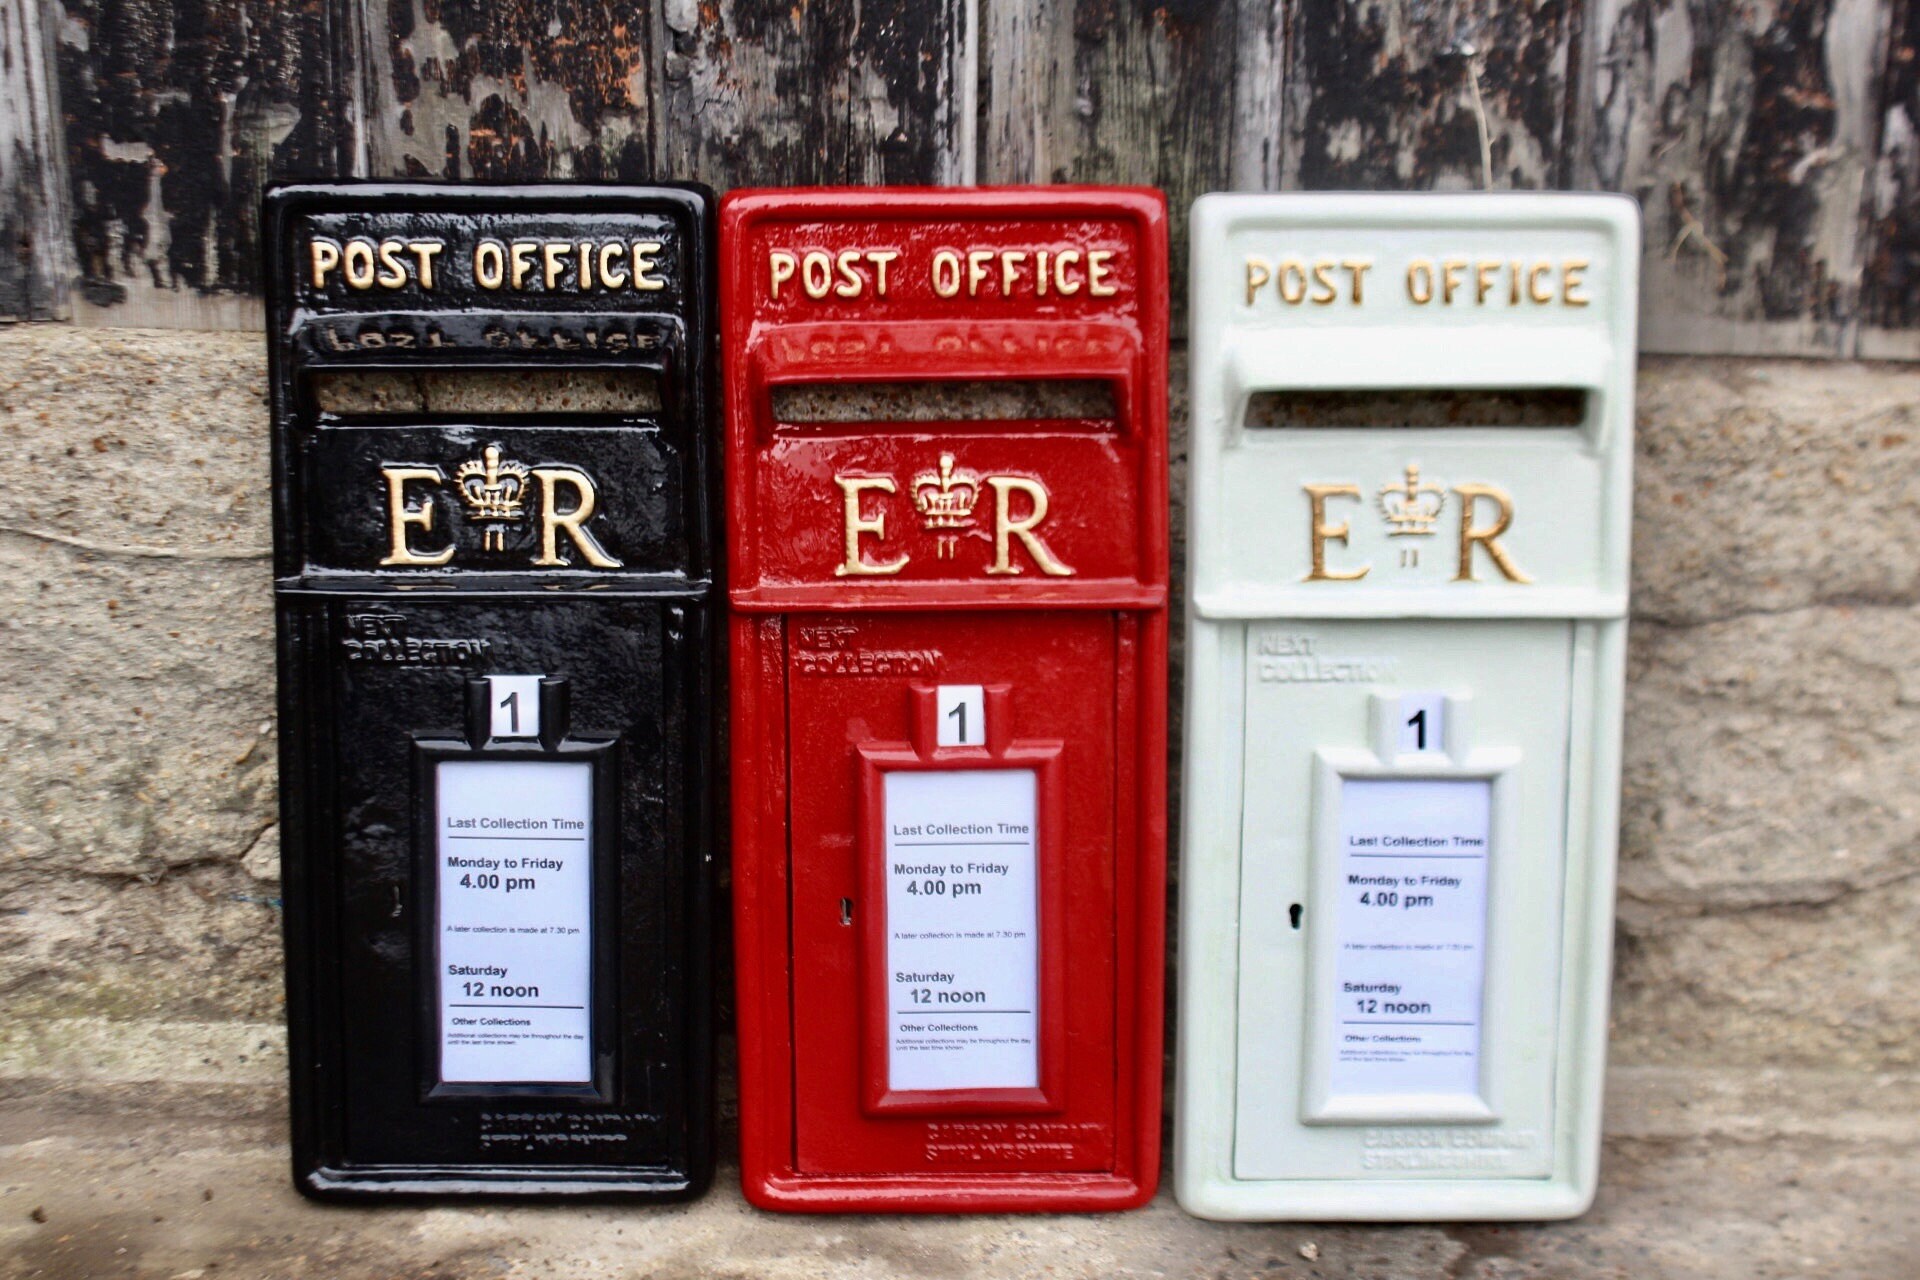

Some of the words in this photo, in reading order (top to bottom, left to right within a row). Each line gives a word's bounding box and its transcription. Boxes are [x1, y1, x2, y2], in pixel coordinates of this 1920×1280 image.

[310, 239, 442, 290] POST
[475, 240, 664, 290] OFFICE
[769, 250, 897, 299] POST
[932, 250, 1117, 298] OFFICE
[1246, 259, 1372, 307] POST
[1407, 259, 1591, 307] OFFICE
[379, 466, 454, 566] E
[532, 468, 623, 567] R
[834, 474, 909, 577] E
[986, 475, 1074, 577] R
[1303, 484, 1371, 583] E
[1451, 484, 1533, 585] R
[796, 649, 943, 674] COLLECTION
[500, 692, 518, 733] 1
[948, 702, 967, 744] 1
[1407, 709, 1427, 751] 1
[448, 817, 476, 828] Last
[480, 818, 548, 829] Collection
[552, 819, 584, 829] Time
[894, 825, 922, 835] Last
[926, 824, 993, 835] Collection
[998, 824, 1028, 833] Time
[1350, 836, 1377, 846] Last
[1383, 837, 1448, 847] Collection
[1453, 837, 1484, 846] Time
[448, 857, 500, 870] Monday
[504, 858, 517, 868] to
[522, 858, 563, 871] Friday
[894, 864, 946, 876] Monday
[951, 864, 963, 874] to
[968, 863, 1009, 875] Friday
[460, 874, 499, 889] 4.00
[506, 878, 535, 892] pm
[907, 880, 945, 895] 4.00
[952, 882, 981, 898] pm
[1348, 875, 1400, 887] Monday
[1404, 876, 1416, 885] to
[1421, 876, 1462, 888] Friday
[1360, 892, 1398, 906] 4.00
[1405, 895, 1433, 909] pm
[449, 965, 507, 978] Saturday
[896, 972, 955, 984] Saturday
[463, 982, 484, 997] 12
[491, 985, 539, 997] noon
[911, 989, 932, 1003] 12
[938, 991, 986, 1003] noon
[1344, 982, 1401, 995] Saturday
[1357, 1000, 1377, 1013] 12
[1385, 1002, 1431, 1014] noon
[452, 1017, 477, 1025] Other
[900, 1024, 924, 1032] Other
